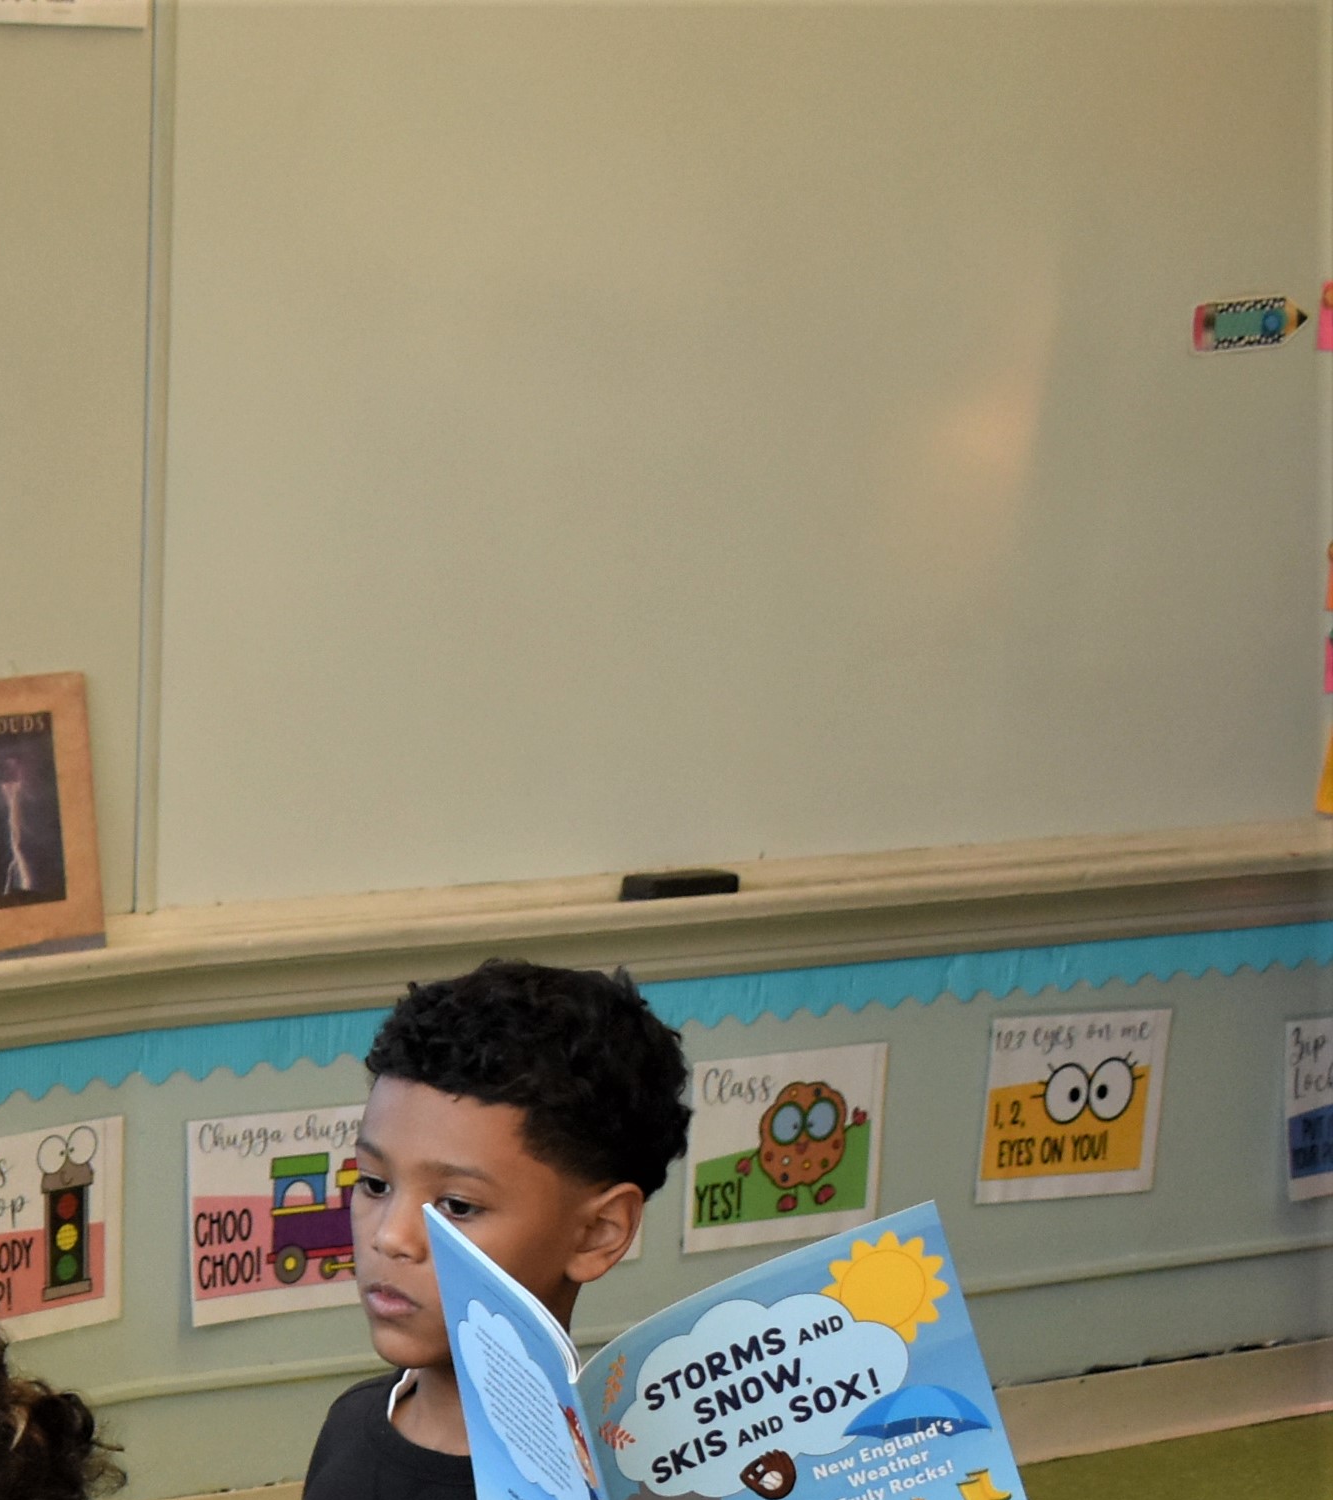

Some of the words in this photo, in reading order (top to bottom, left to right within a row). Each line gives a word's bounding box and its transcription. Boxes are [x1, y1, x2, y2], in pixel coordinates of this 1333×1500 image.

[1032, 1024, 1076, 1054] eyes
[1121, 1020, 1151, 1041] me
[702, 1067, 777, 1105] Class
[198, 1121, 284, 1157] Chugga
[293, 1114, 362, 1149] chugg
[997, 1136, 1035, 1169] EYES
[1040, 1134, 1068, 1165] ON
[694, 1177, 743, 1223] YES!
[194, 1208, 253, 1248] CHOO
[197, 1246, 262, 1290] CHOO!
[643, 1327, 786, 1411] STORMS
[798, 1314, 844, 1347] AND
[693, 1358, 813, 1425] SNOW,
[651, 1429, 728, 1484] SKIS
[737, 1415, 784, 1448] AND
[789, 1367, 881, 1423] SOX!
[812, 1456, 856, 1481] New
[860, 1419, 954, 1464] England's
[846, 1448, 930, 1488] Weather
[889, 1459, 955, 1494] Rocks!
